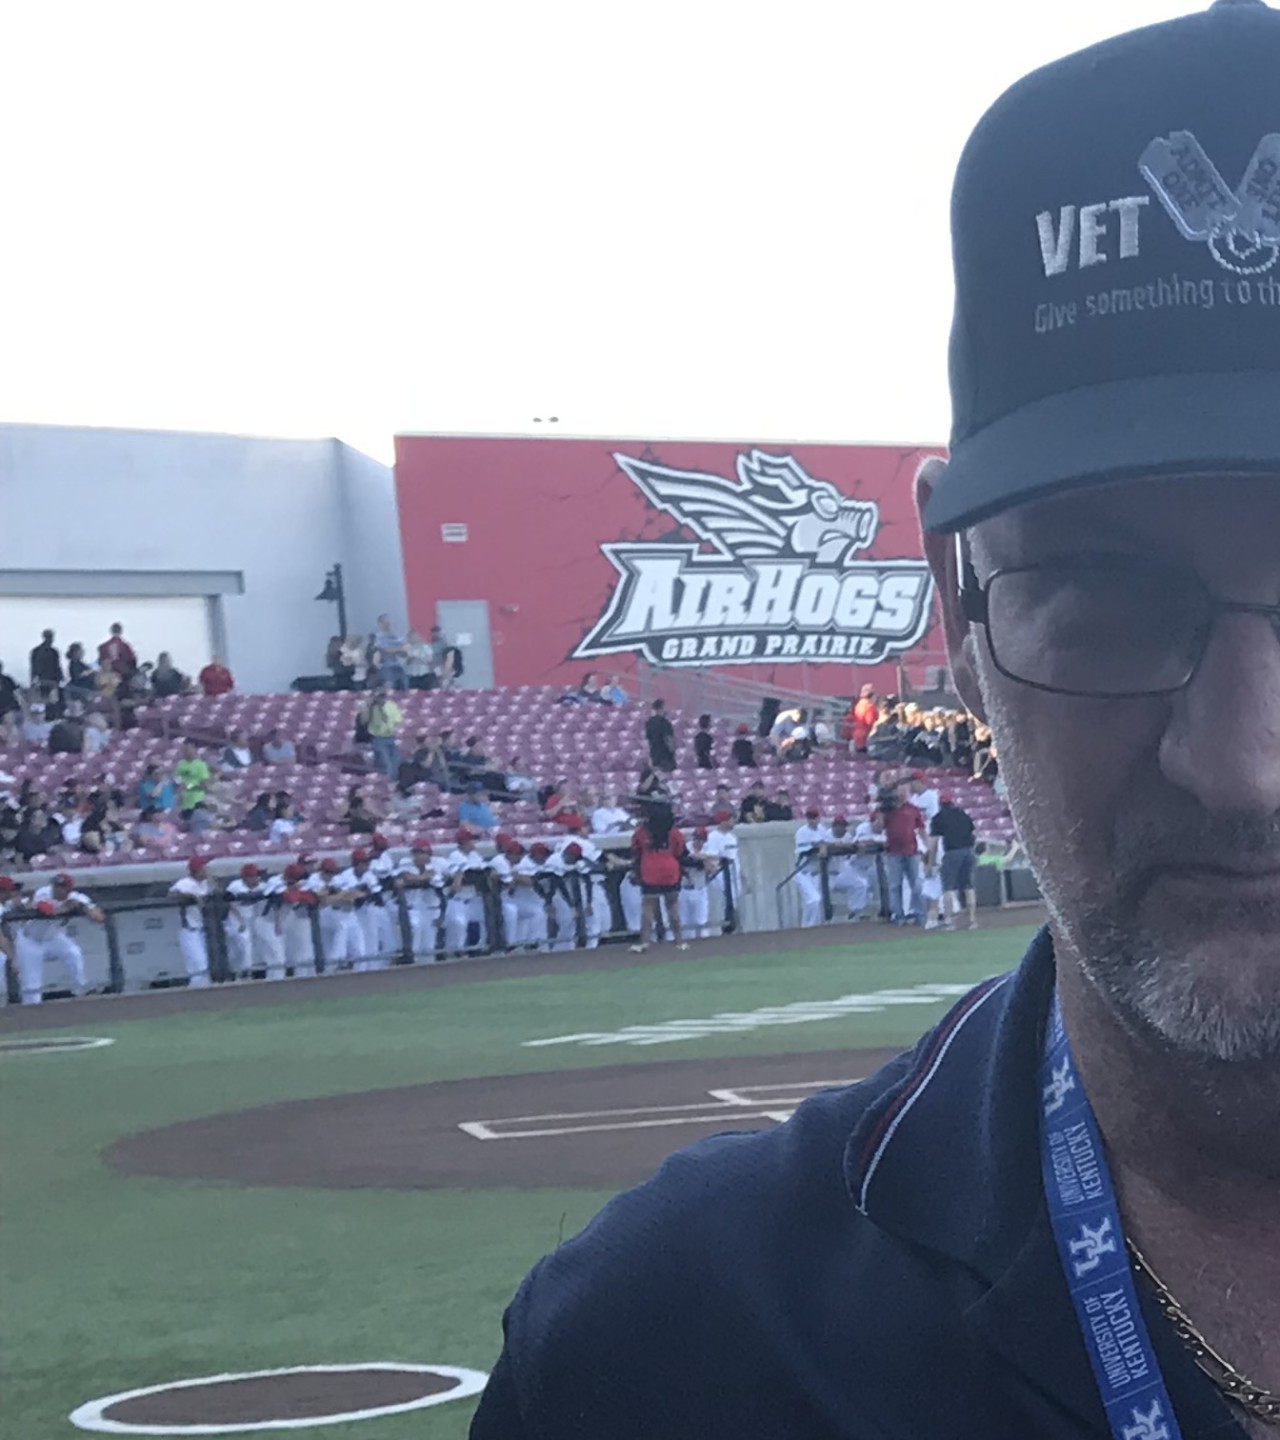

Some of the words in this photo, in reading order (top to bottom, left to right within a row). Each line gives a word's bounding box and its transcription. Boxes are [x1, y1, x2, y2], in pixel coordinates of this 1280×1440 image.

[1036, 195, 1150, 277] VET
[1034, 302, 1077, 334] Give
[1085, 272, 1214, 316] something
[1221, 278, 1251, 304] to
[661, 635, 756, 660] GRAND
[763, 634, 877, 657] PRAIRIE
[1051, 1144, 1085, 1207] UNIVERSITY
[1063, 1121, 1103, 1200] KENTUCKY
[1084, 1296, 1102, 1314] OF
[1101, 1286, 1149, 1380] KENTUCKY
[1090, 1316, 1131, 1389] UNIVERSITY
